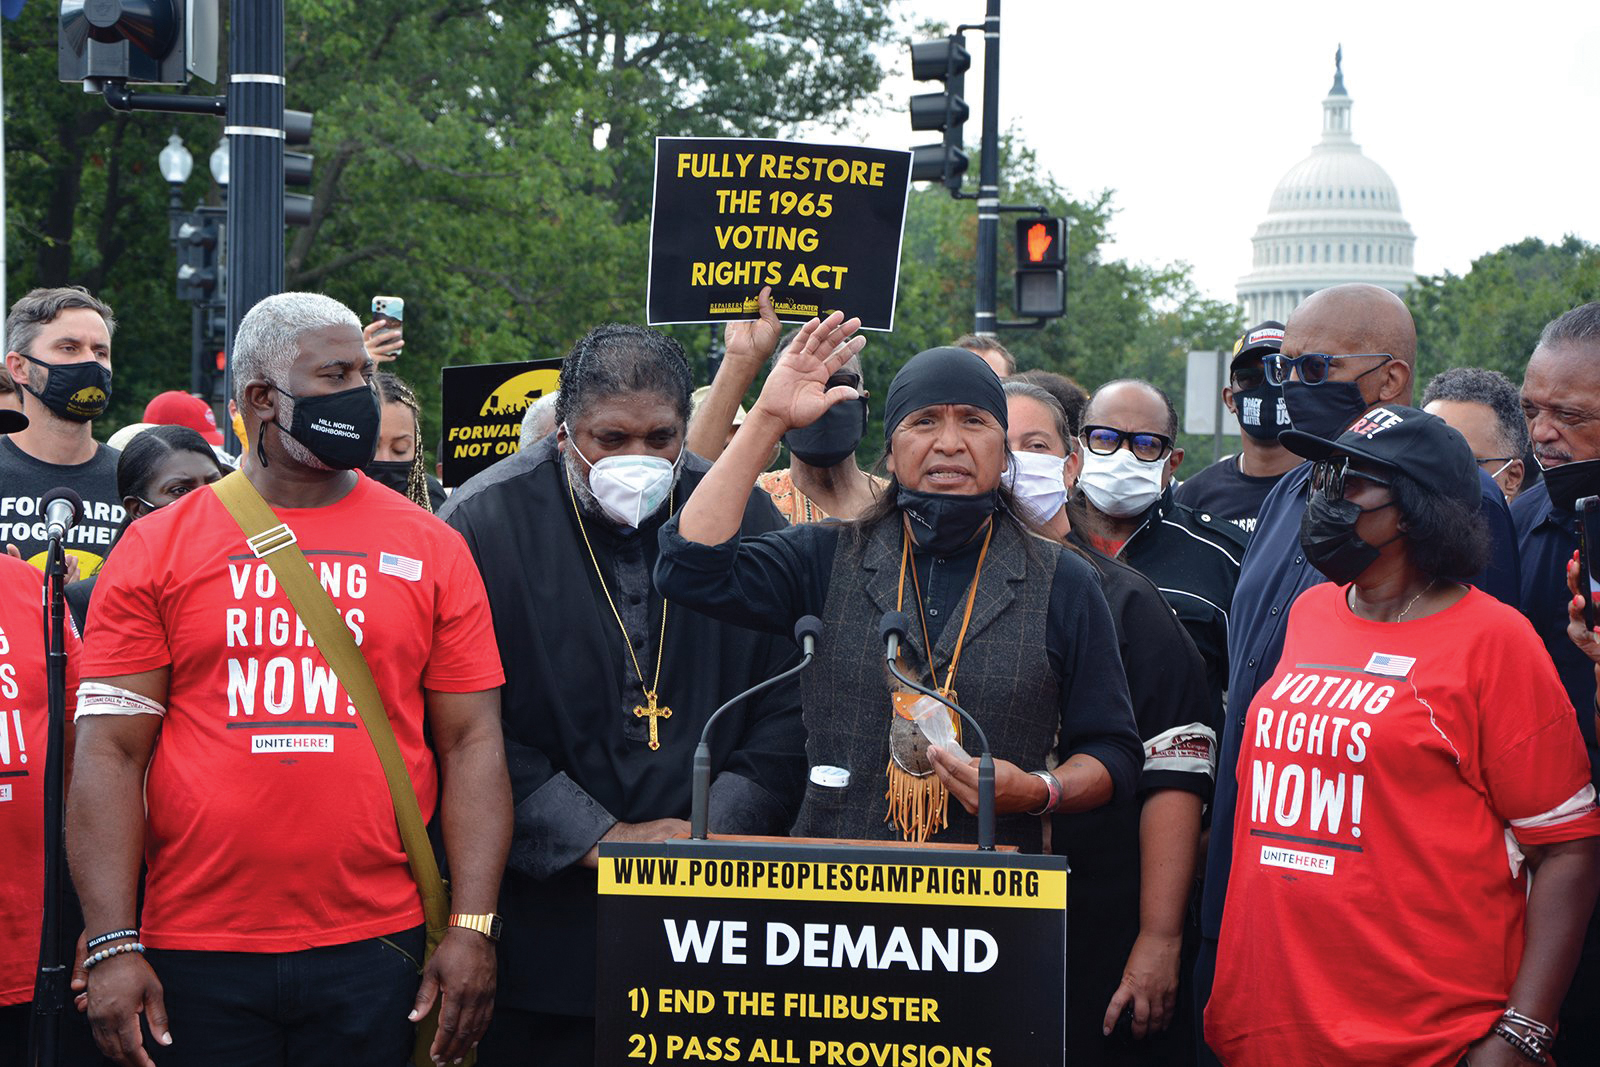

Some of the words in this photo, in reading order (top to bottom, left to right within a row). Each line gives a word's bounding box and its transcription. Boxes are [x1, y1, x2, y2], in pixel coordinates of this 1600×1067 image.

[677, 153, 755, 178] FULLY
[759, 154, 885, 187] RESTORE
[716, 189, 762, 214] THE
[769, 190, 833, 218] 1965
[715, 225, 819, 252] VOTING
[691, 261, 782, 287] RIGHTS
[788, 263, 848, 290] ACT
[797, 303, 818, 312] CENTER
[310, 423, 361, 440] NEIGHBORHOOD
[318, 418, 332, 427] HILL
[333, 422, 354, 431] NORTH
[448, 424, 522, 441] FORWAR
[1348, 418, 1386, 440] RE!
[1363, 407, 1403, 429] ITE
[454, 443, 492, 458] NOT
[495, 441, 521, 455] ON
[0, 496, 127, 524] FOARD
[0, 522, 119, 545] TOGTHE
[229, 562, 367, 600] VONG
[226, 607, 365, 647] RIGHS
[1272, 673, 1395, 714] VOTING
[1255, 707, 1371, 763] RIGHTS
[1251, 760, 1364, 838] NOW!
[613, 857, 1040, 898] WWW.POORPEOPLESCAMPAIGN.ORG
[663, 918, 748, 966] WE
[766, 921, 1000, 973] DEMAND
[628, 987, 649, 1018] 1)
[658, 988, 715, 1014] END
[723, 991, 775, 1016] THE
[784, 993, 941, 1023] FILIBUSTER
[628, 1033, 658, 1065] 2)
[666, 1035, 741, 1062] PASS
[748, 1038, 800, 1064] ALL
[809, 1040, 993, 1067] PROVISIONS
